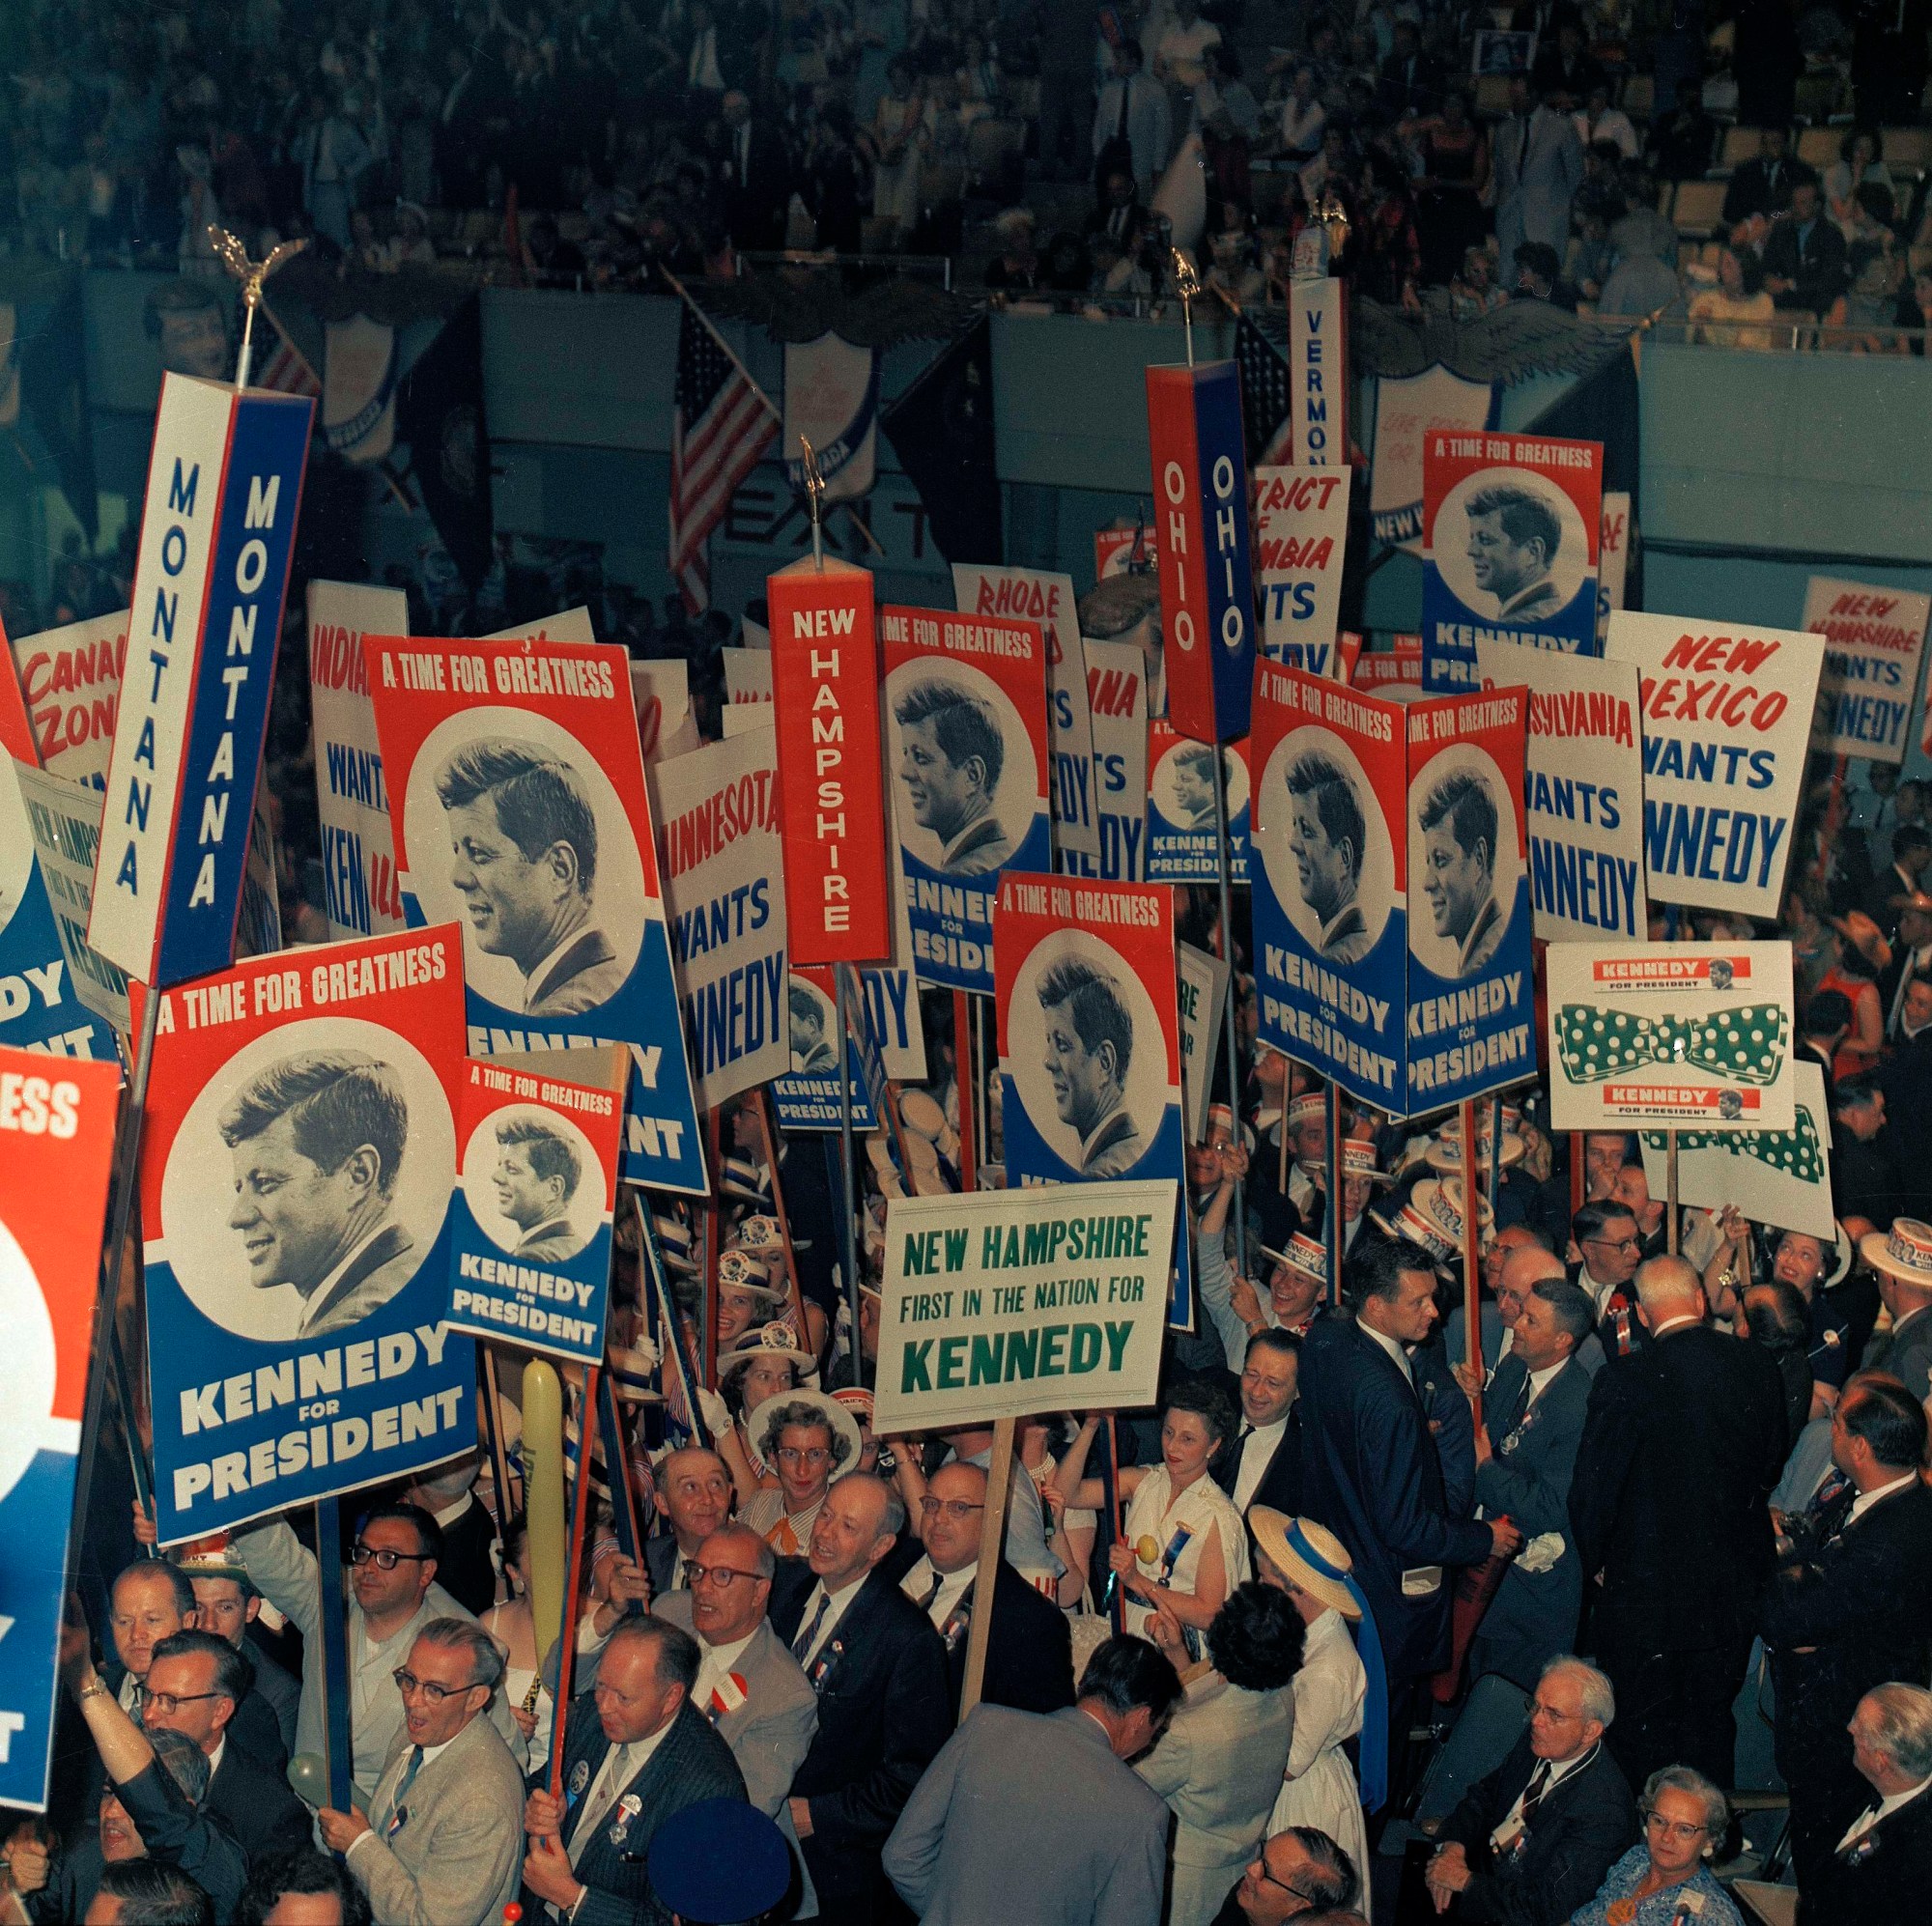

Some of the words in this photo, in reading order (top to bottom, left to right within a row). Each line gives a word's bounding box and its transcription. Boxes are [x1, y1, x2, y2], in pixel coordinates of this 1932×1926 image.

[1307, 310, 1327, 466] VERMO
[1435, 439, 1445, 457] A
[1450, 439, 1482, 458] TIME
[1487, 441, 1510, 461] FOR
[1515, 444, 1592, 469] GREATNESS
[1256, 476, 1341, 512] TRICT
[1164, 462, 1194, 650] OHIO
[1213, 456, 1243, 646] OHIO
[1260, 536, 1334, 571] MBIA
[792, 609, 856, 638] NEW
[976, 576, 1059, 618] RHODE
[1830, 593, 1900, 618] NEW
[311, 624, 372, 697] INDIA
[885, 616, 908, 642] ME
[913, 619, 939, 647] FOR
[944, 623, 1032, 660] GREATNESS
[1662, 634, 1781, 675] NEW
[116, 457, 199, 895] MONTANA
[188, 475, 280, 908] MONTANA
[383, 652, 397, 689] A
[398, 653, 446, 693] TIME
[449, 655, 490, 694] FOR
[495, 656, 614, 699] GREATNESS
[34, 694, 115, 762] ZON
[1260, 671, 1268, 697] A
[1271, 673, 1299, 710] TIME
[1302, 684, 1321, 717] FOR
[1325, 693, 1392, 743] GREATNESS
[1408, 713, 1430, 743] IME
[1432, 709, 1455, 739] FOR
[1459, 696, 1519, 733] GREATNESS
[1527, 687, 1634, 749] SYLVANIA
[327, 742, 388, 812] WANT
[810, 649, 851, 932] HAMPSHIRE
[663, 769, 781, 881] INNESOTA
[1152, 836, 1244, 851] KENNEY
[1645, 799, 1787, 889] NNEDY
[1150, 859, 1247, 872] PRESIDT
[1531, 836, 1637, 937] NNEDY
[941, 919, 963, 935] FOR
[1003, 883, 1011, 911] A
[1015, 884, 1047, 916] TIME
[1050, 887, 1072, 919] FOR
[1075, 890, 1159, 927] GREATNESS
[155, 994, 176, 1036] A
[183, 982, 246, 1030] TIME
[254, 971, 302, 1017] FOR
[312, 943, 447, 1007] GREATNESS
[1264, 943, 1390, 1034] KENNEDY
[1602, 961, 1698, 978] KENNEDY
[1635, 980, 1698, 989] PRESIDENT
[688, 950, 783, 1080] NNEDY
[1320, 1005, 1336, 1024] FOR
[1407, 971, 1522, 1039] KENNEDY
[1263, 994, 1396, 1090] PRESIDENT
[1459, 1025, 1476, 1040] FOR
[470, 1065, 480, 1084] A
[484, 1068, 512, 1092] TIME
[515, 1075, 538, 1099] FOR
[541, 1081, 613, 1117] GREATNESS
[1612, 1089, 1708, 1103] KENNEDY
[1645, 1107, 1707, 1116] PRESIDENT
[1345, 1149, 1370, 1160] NNEDY
[903, 1228, 969, 1277] NEW
[980, 1214, 1152, 1270] HAMPSHIRE
[460, 1253, 595, 1308] KENNEDY
[516, 1291, 536, 1304] FOR
[899, 1291, 953, 1323] FIRST
[962, 1289, 981, 1317] IN
[993, 1286, 1026, 1315] THE
[1034, 1278, 1099, 1310] NATION
[1107, 1276, 1145, 1303] FOR
[452, 1289, 598, 1346] PRESIDENT
[180, 1319, 451, 1436] KENNEDY
[900, 1320, 1134, 1394] KENNEDY
[298, 1400, 340, 1422] FOR
[173, 1385, 464, 1512] PRESIDENT
